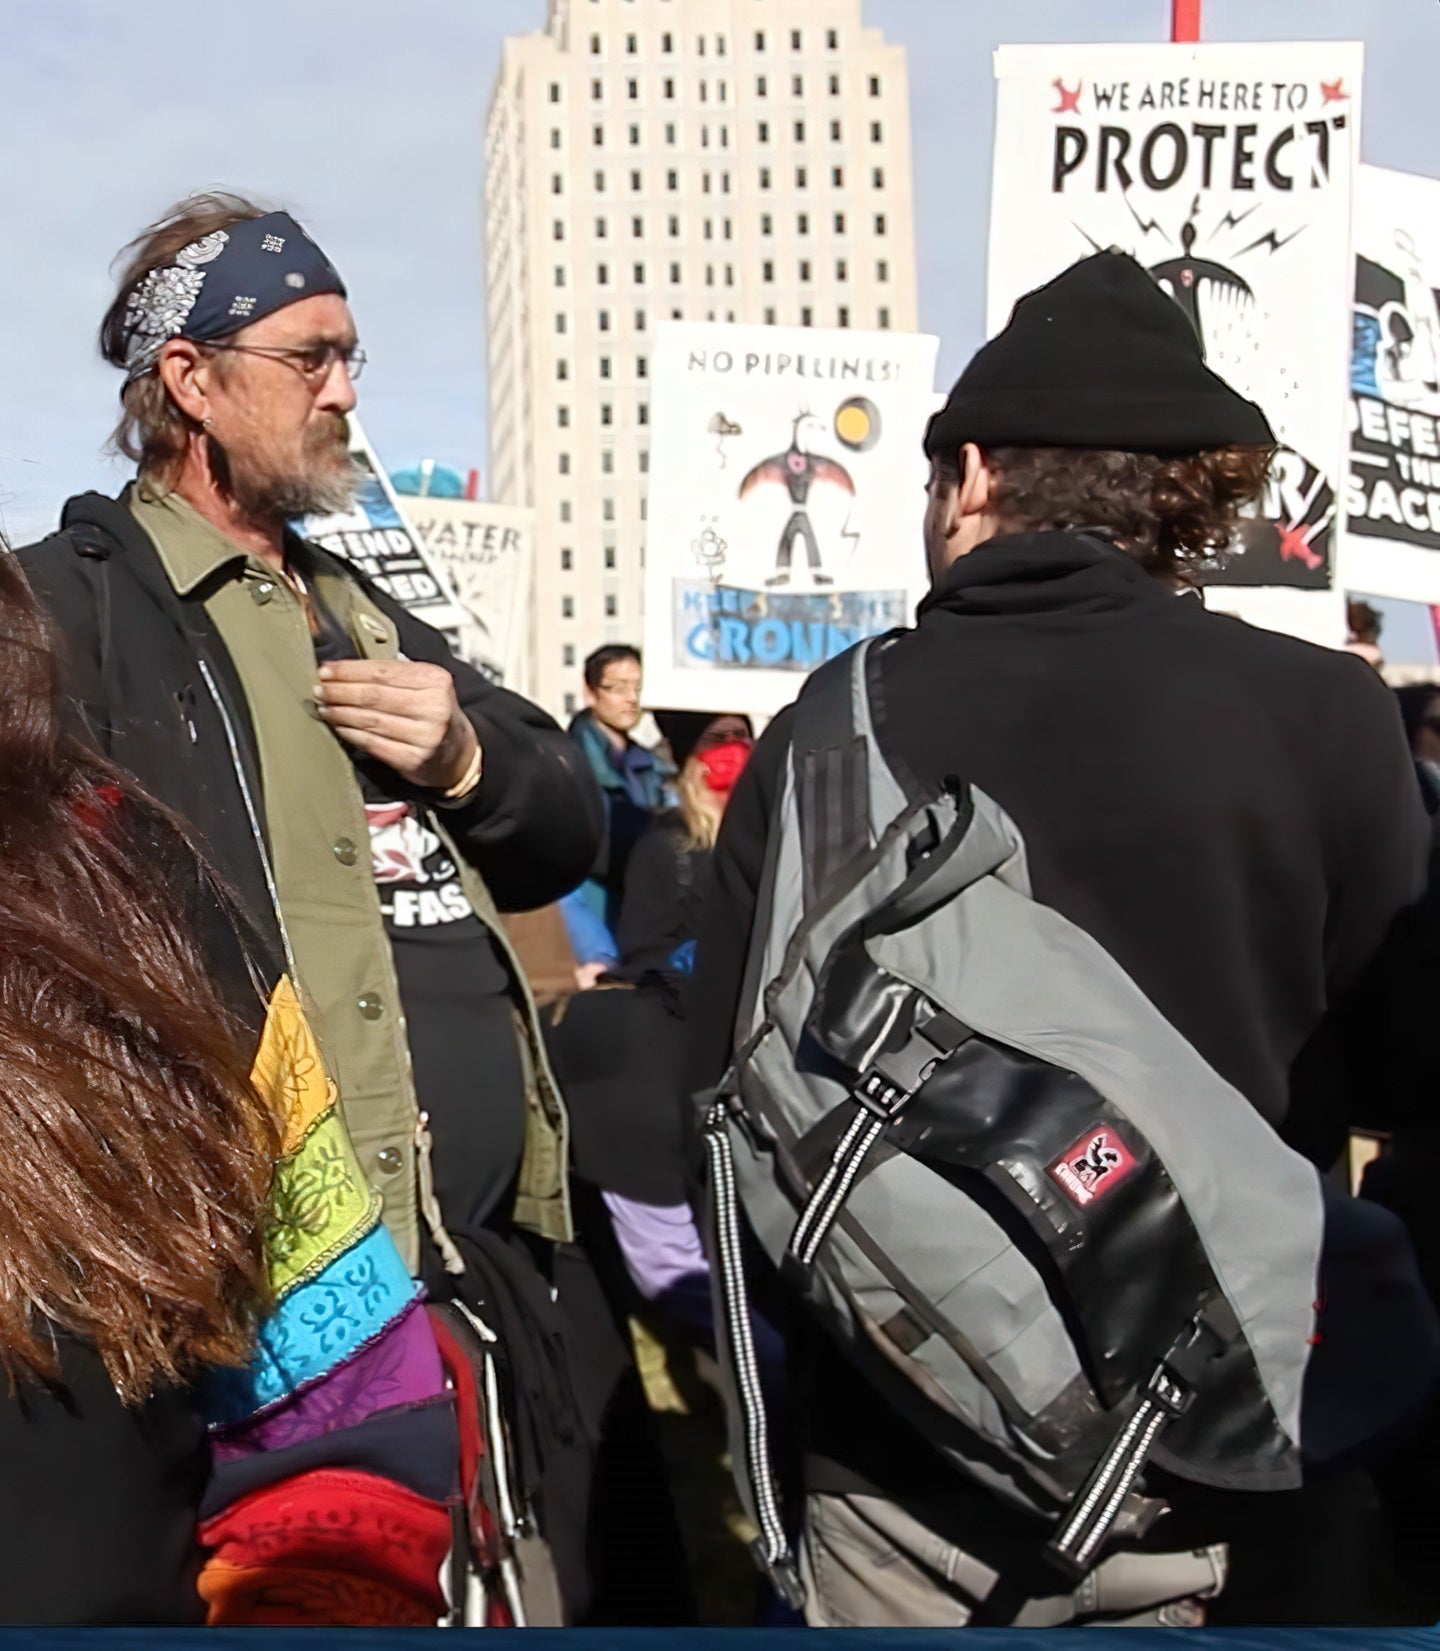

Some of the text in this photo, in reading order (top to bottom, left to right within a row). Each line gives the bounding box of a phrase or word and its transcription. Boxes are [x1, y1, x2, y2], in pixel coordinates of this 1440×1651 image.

[1093, 77, 1308, 112] WE ARE HERE TO
[1051, 115, 1346, 194] PROTECT
[688, 351, 733, 373] NO
[687, 617, 866, 666] GROUN
